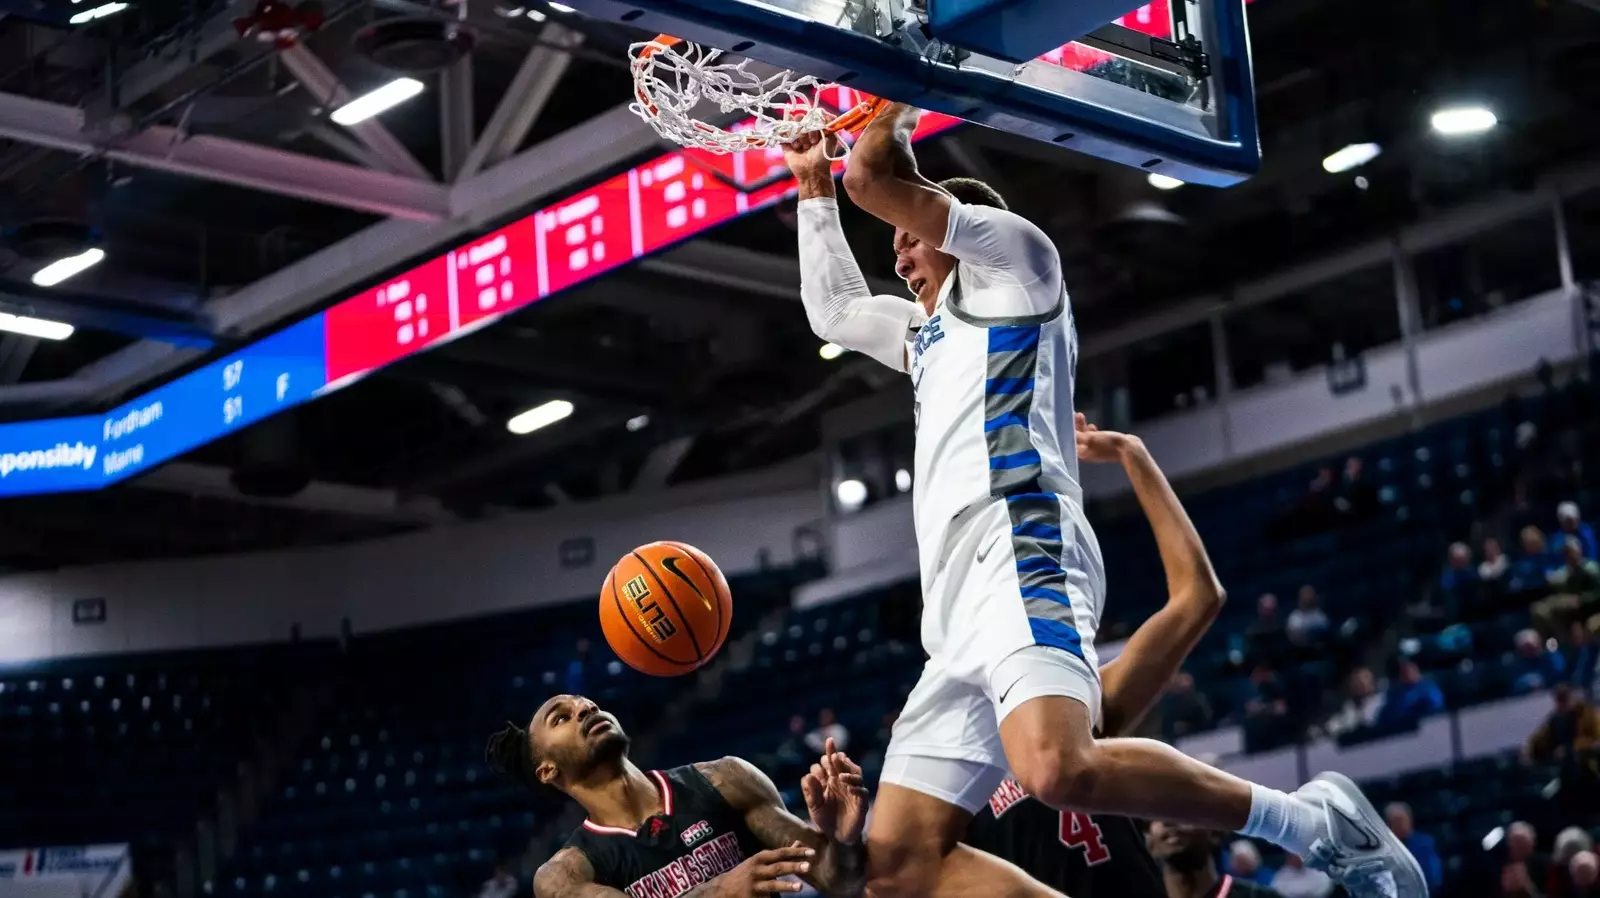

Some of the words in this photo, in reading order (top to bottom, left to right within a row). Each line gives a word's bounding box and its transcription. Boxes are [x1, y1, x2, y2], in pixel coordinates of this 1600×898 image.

[914, 315, 945, 356] RCE
[103, 402, 163, 440] Fordham
[223, 361, 243, 391] 57
[276, 372, 290, 401] F
[0, 442, 97, 478] ponsibly
[621, 585, 662, 644] CHAIONSHIP
[626, 574, 677, 641] ELITE
[989, 779, 1029, 819] ARK
[681, 820, 713, 847] SBC
[693, 831, 744, 878] STATE
[1059, 810, 1112, 867] 4
